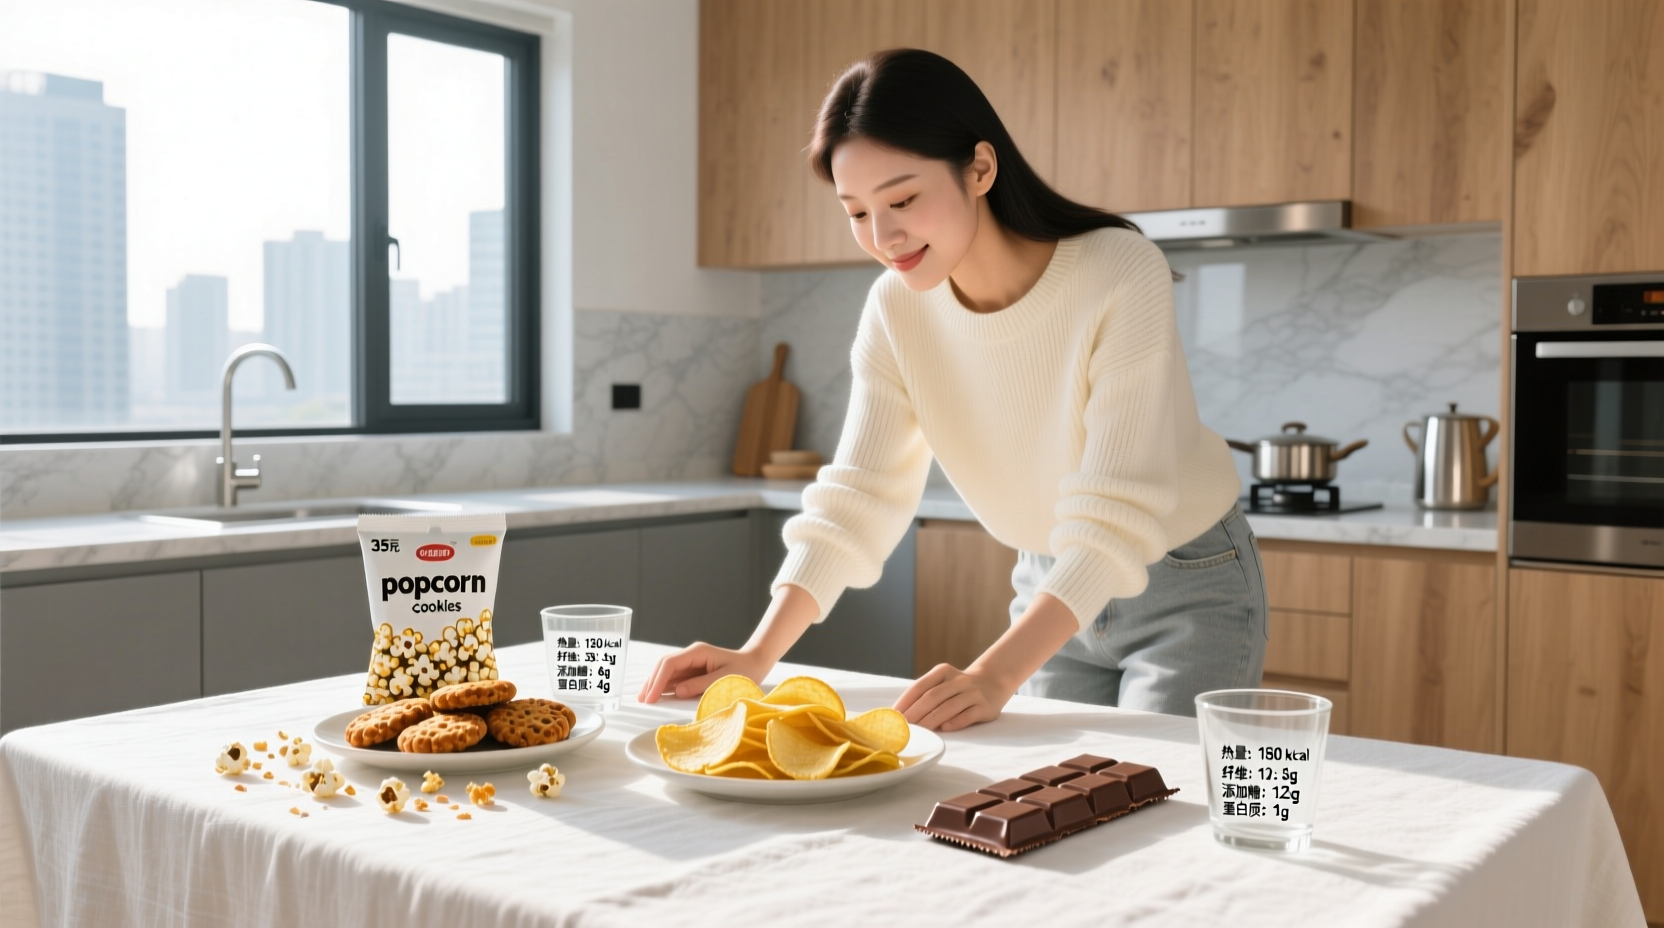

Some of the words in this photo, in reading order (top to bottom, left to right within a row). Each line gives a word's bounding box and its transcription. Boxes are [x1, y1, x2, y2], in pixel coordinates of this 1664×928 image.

[371, 538, 400, 553] 35元
[382, 574, 486, 601] popcorn
[411, 599, 462, 613] cookies
[597, 666, 611, 679] 6g
[596, 679, 610, 693] 4g
[1271, 785, 1300, 804] 12g
[1272, 803, 1290, 821] 1g
